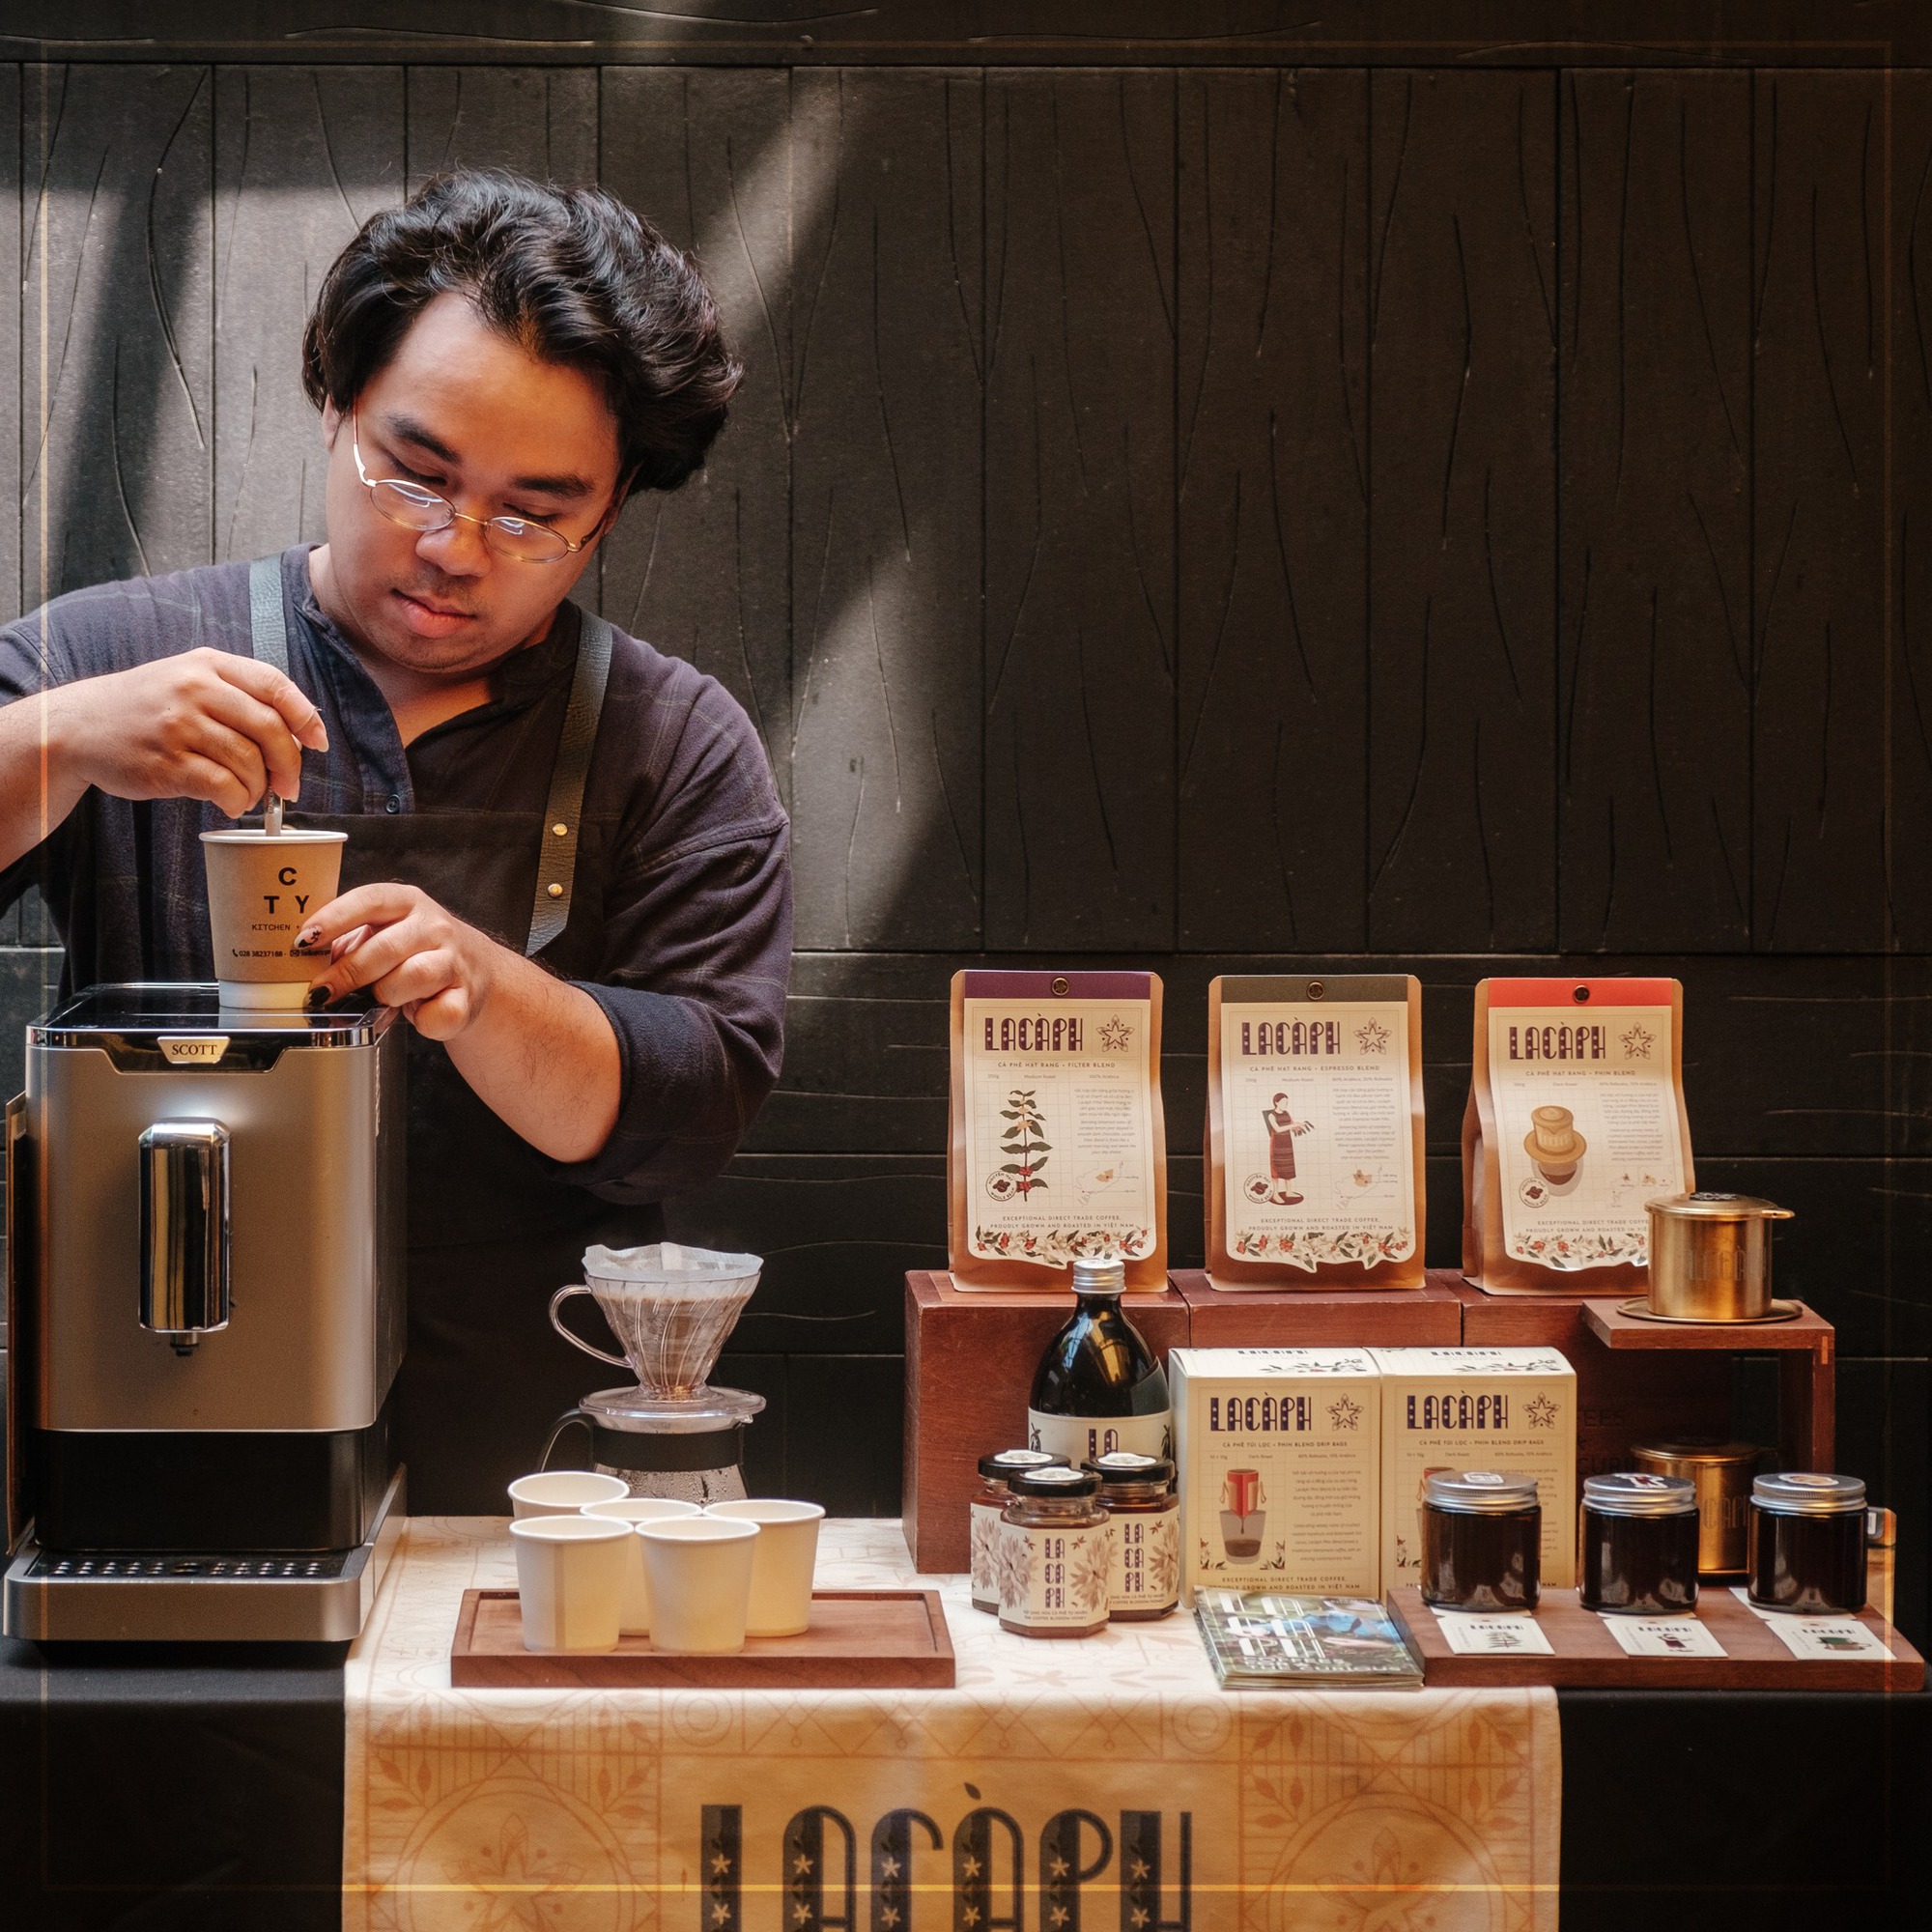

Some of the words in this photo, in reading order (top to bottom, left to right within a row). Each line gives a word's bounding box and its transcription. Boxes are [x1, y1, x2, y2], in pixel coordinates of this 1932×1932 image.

[171, 1043, 217, 1056] SCOTT
[1124, 1523, 1144, 1544] LA
[1044, 1538, 1065, 1559] LA
[1124, 1572, 1144, 1592] PH
[1045, 1588, 1065, 1608] PH
